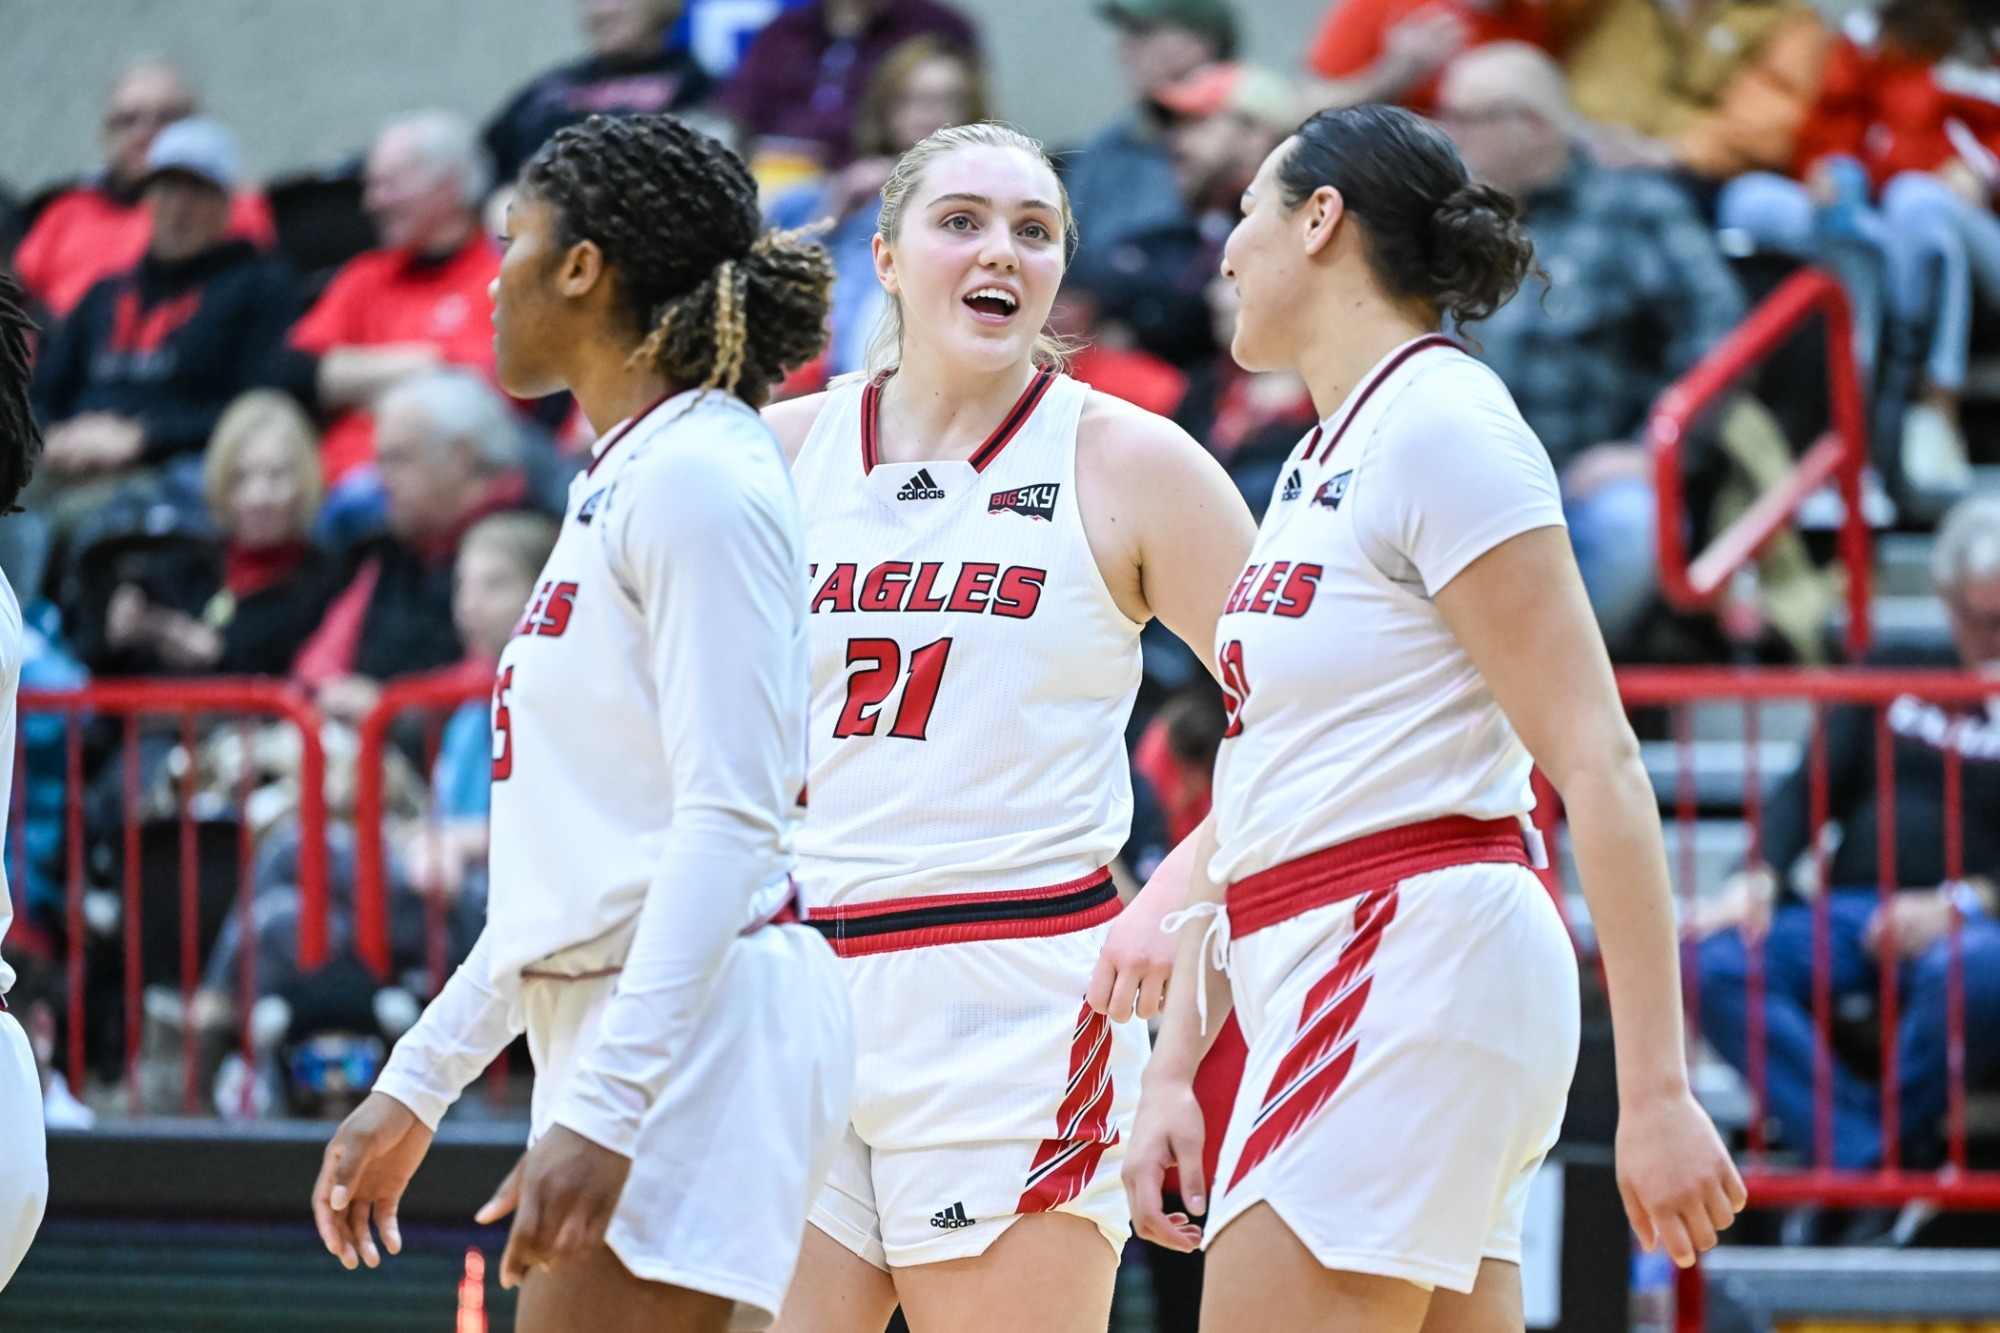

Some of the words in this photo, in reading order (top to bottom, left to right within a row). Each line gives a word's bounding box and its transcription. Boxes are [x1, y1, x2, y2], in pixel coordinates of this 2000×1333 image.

[896, 487, 946, 502] adidas
[809, 561, 1047, 620] AGLES
[832, 637, 953, 741] 21
